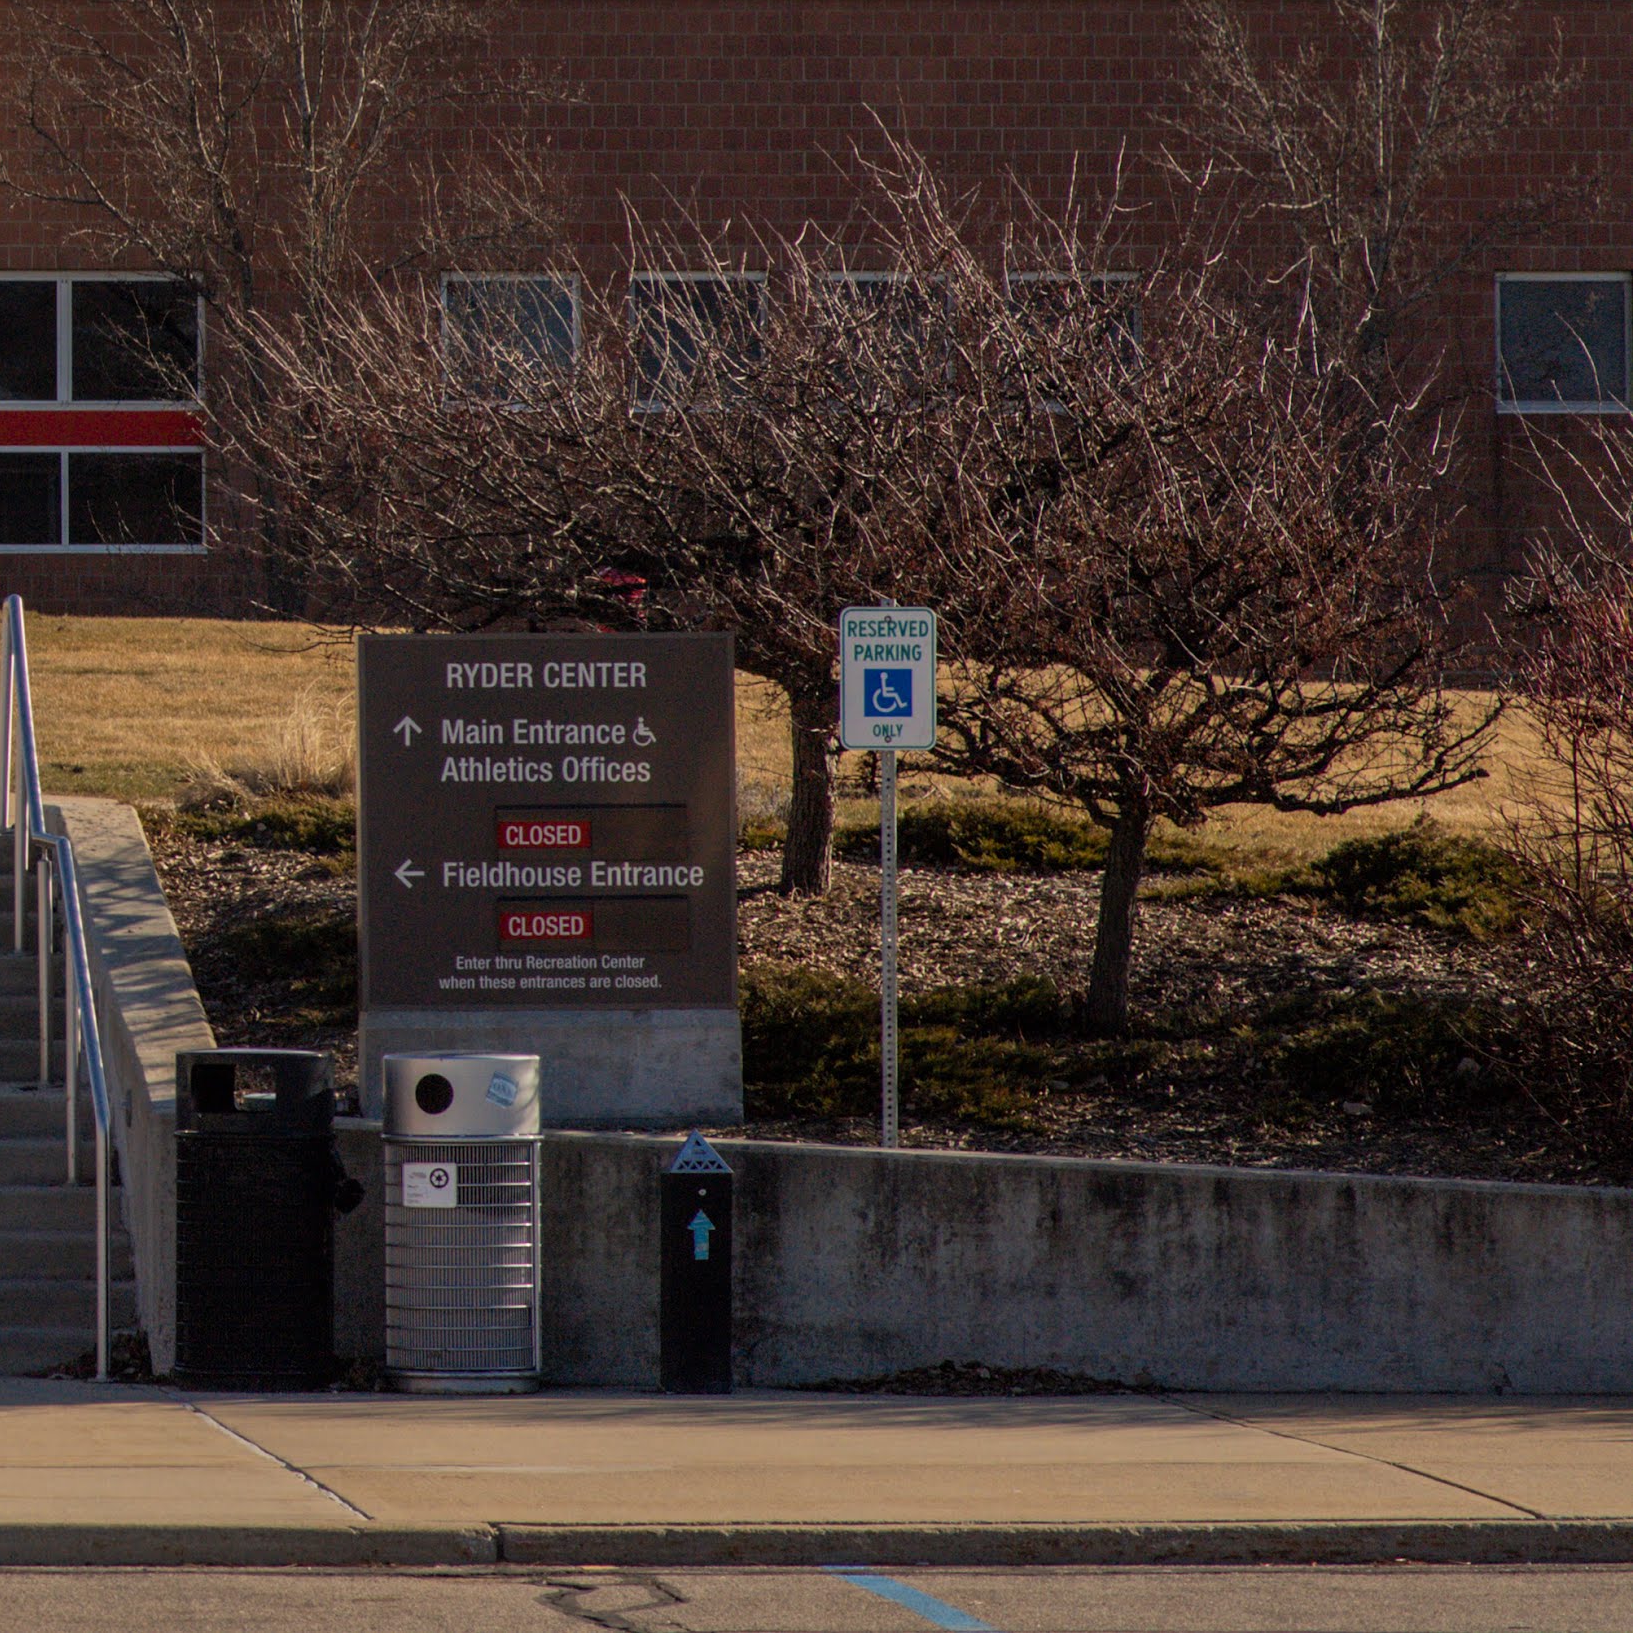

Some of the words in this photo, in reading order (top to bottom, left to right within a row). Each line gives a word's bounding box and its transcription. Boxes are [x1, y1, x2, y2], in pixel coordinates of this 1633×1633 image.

[847, 620, 929, 637] RESERVED
[854, 644, 922, 661] PARKING
[446, 662, 534, 688] RYDER
[543, 662, 647, 688] CENTER
[441, 718, 504, 745] Main
[512, 718, 626, 745] Entrance
[872, 724, 903, 737] ONLY
[440, 756, 553, 783] Athletics
[562, 756, 651, 783] Offices
[505, 825, 582, 846] CLOSED
[442, 861, 582, 888] Fieldhouse
[590, 861, 705, 888] Entrance
[508, 916, 584, 937] CLOSED
[456, 955, 491, 971] Enter
[495, 955, 522, 971] thru
[526, 955, 597, 971] Recreation
[601, 955, 646, 971] Center
[439, 975, 475, 990] when
[479, 975, 516, 990] these
[520, 975, 586, 990] entrances
[589, 975, 611, 990] are
[614, 975, 663, 990] closed.
